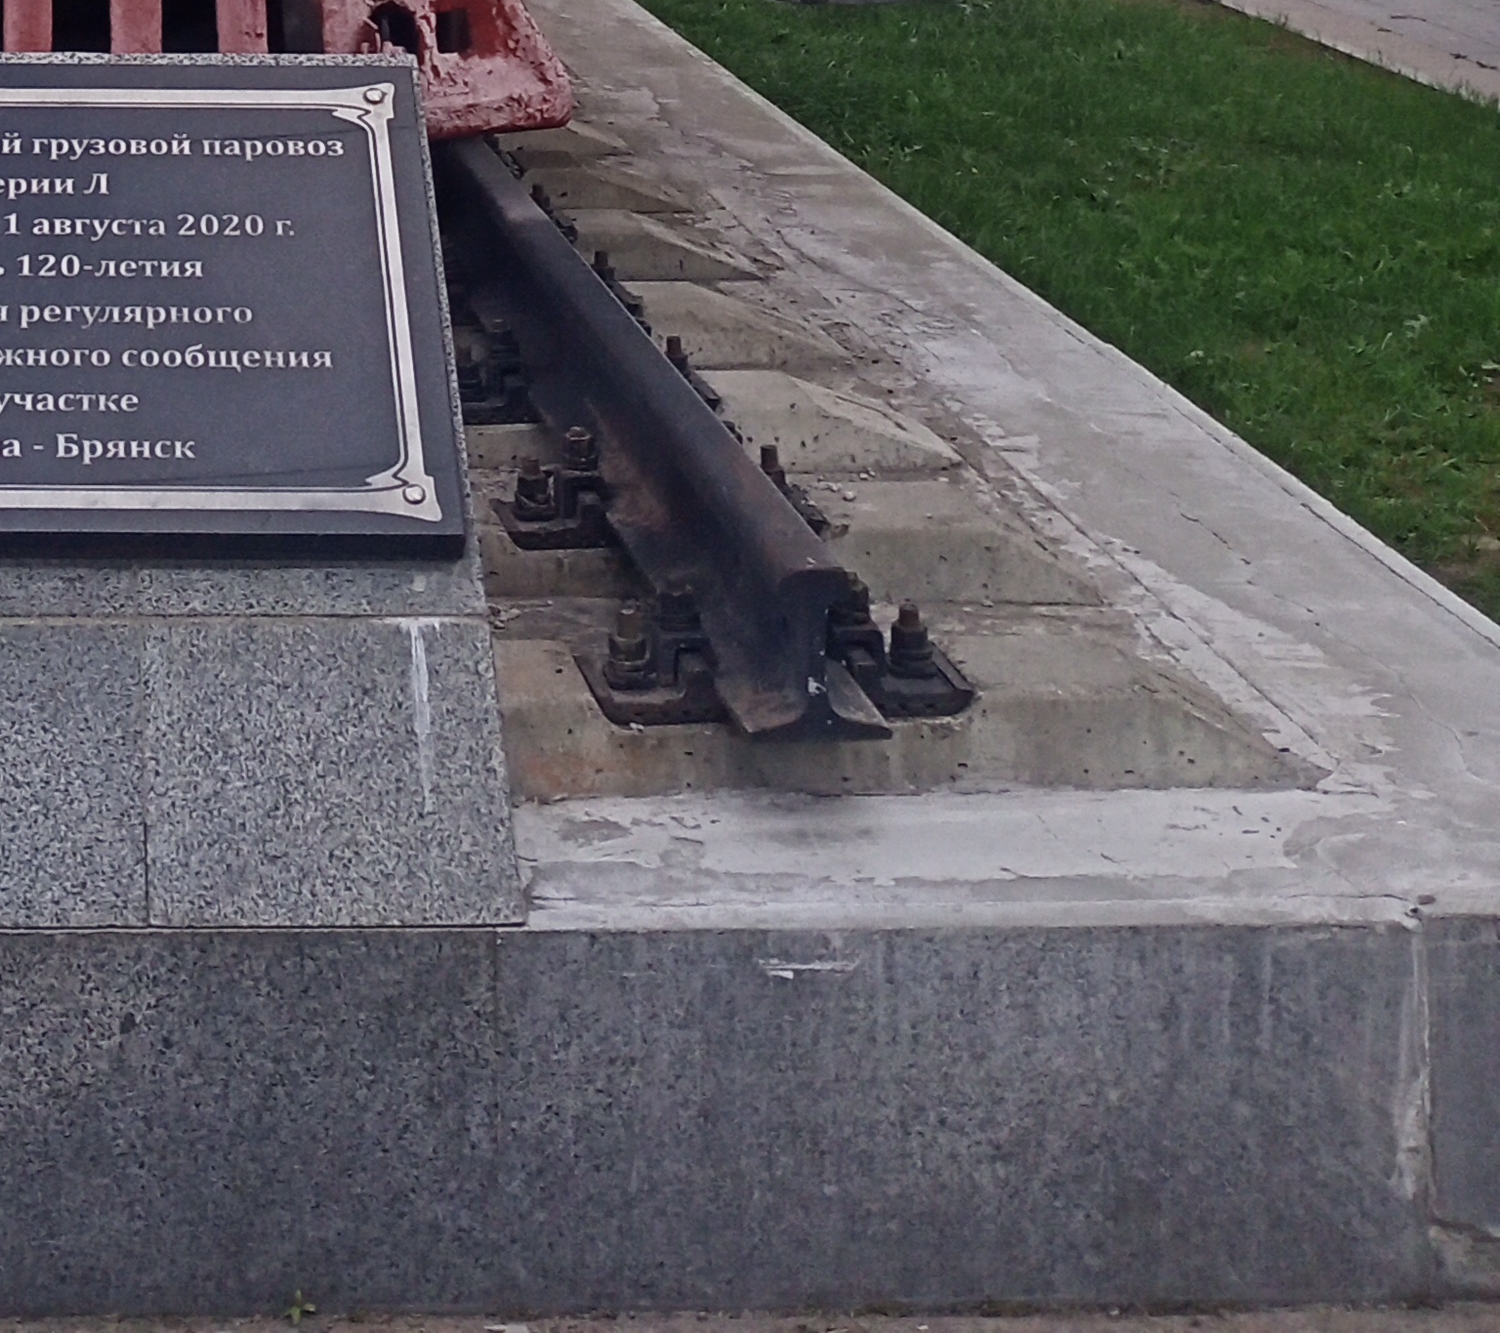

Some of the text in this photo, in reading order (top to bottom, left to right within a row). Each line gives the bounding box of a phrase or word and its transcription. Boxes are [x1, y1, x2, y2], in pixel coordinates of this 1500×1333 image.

[31, 132, 192, 161] грузовой
[202, 139, 344, 162] паровоз
[82, 172, 109, 195] Л
[3, 212, 21, 235] 1
[32, 218, 166, 242] августа
[177, 213, 264, 236] 2020
[275, 220, 295, 236] г.
[16, 254, 203, 278] 120-летия
[19, 304, 253, 330] регулярного
[121, 343, 333, 373] сообщения
[55, 433, 196, 465] Брянск
